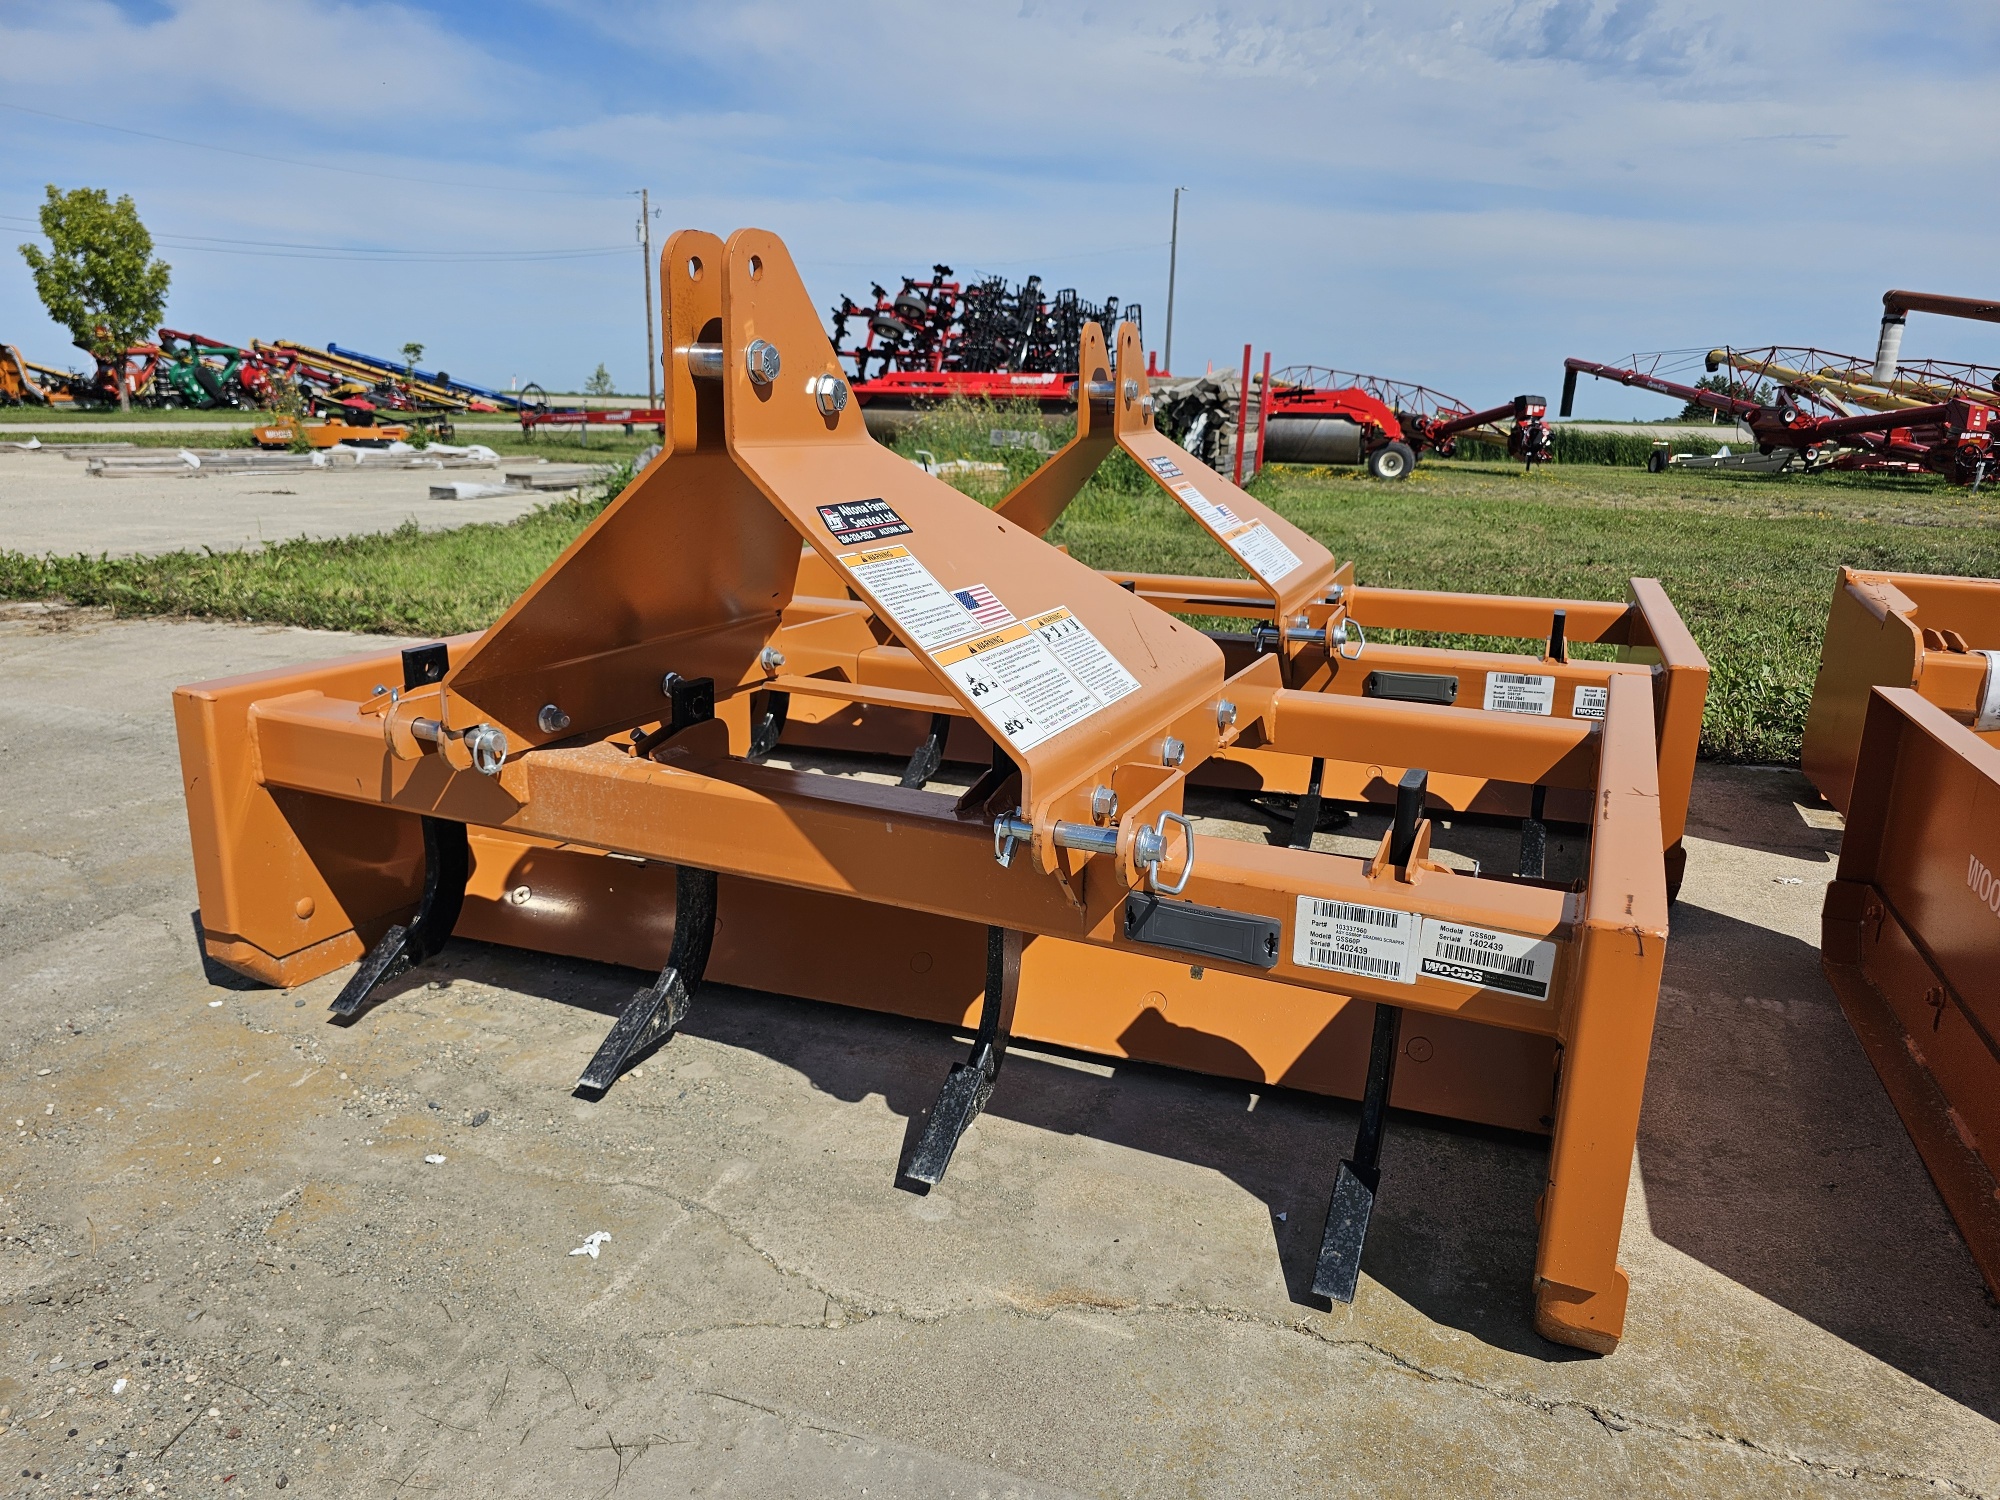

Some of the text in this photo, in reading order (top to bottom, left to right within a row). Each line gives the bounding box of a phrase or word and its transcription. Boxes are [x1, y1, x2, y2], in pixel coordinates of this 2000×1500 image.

[838, 502, 890, 517] Altona Farm
[849, 511, 900, 528] Service Ltd.
[975, 635, 1004, 650] WARNING
[1967, 853, 2000, 919] WOO
[1311, 919, 1328, 928] Part#
[1309, 930, 1361, 945] Model# GSS60P
[1440, 925, 1497, 941] Model# GSS60P
[1309, 939, 1368, 955] Serial# 1402439
[1438, 933, 1504, 952] Serial# 1402439
[1424, 960, 1483, 982] WOODS
